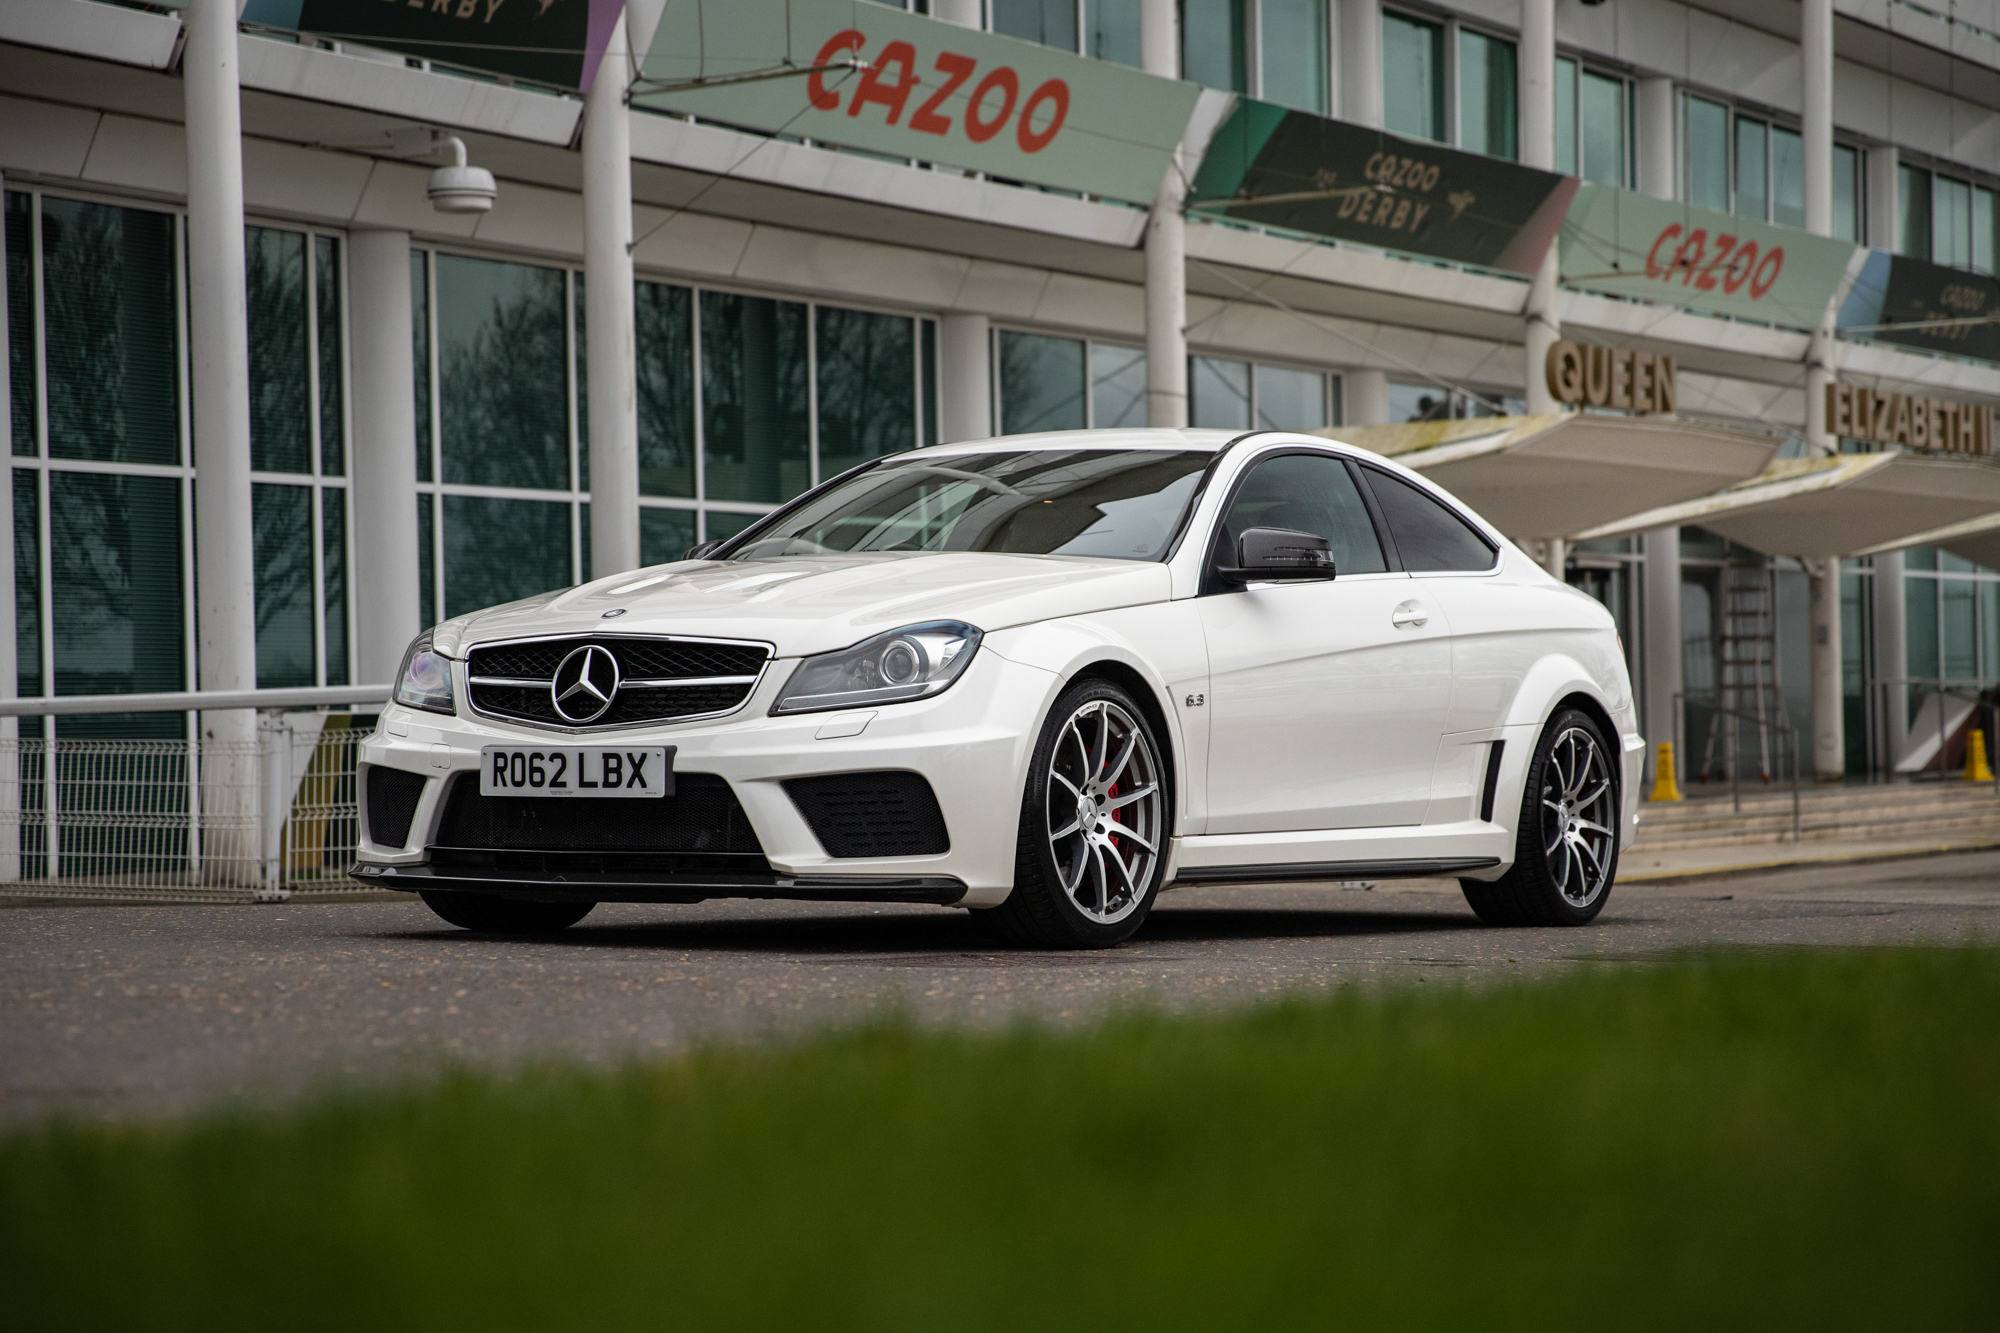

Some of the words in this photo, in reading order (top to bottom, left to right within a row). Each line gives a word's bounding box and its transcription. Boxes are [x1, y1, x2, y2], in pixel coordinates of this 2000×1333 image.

[381, 0, 505, 24] RBY
[806, 28, 1071, 155] CAZOO
[1364, 151, 1441, 192] CAZOO
[1337, 190, 1431, 233] DERBY
[1645, 222, 1785, 300] CAZOO
[1547, 340, 1677, 413] QUEEN
[1826, 383, 1975, 451] ELIZABETH
[1186, 693, 1204, 707] 6.3
[493, 752, 567, 788] RO62
[578, 752, 648, 789] LBX
